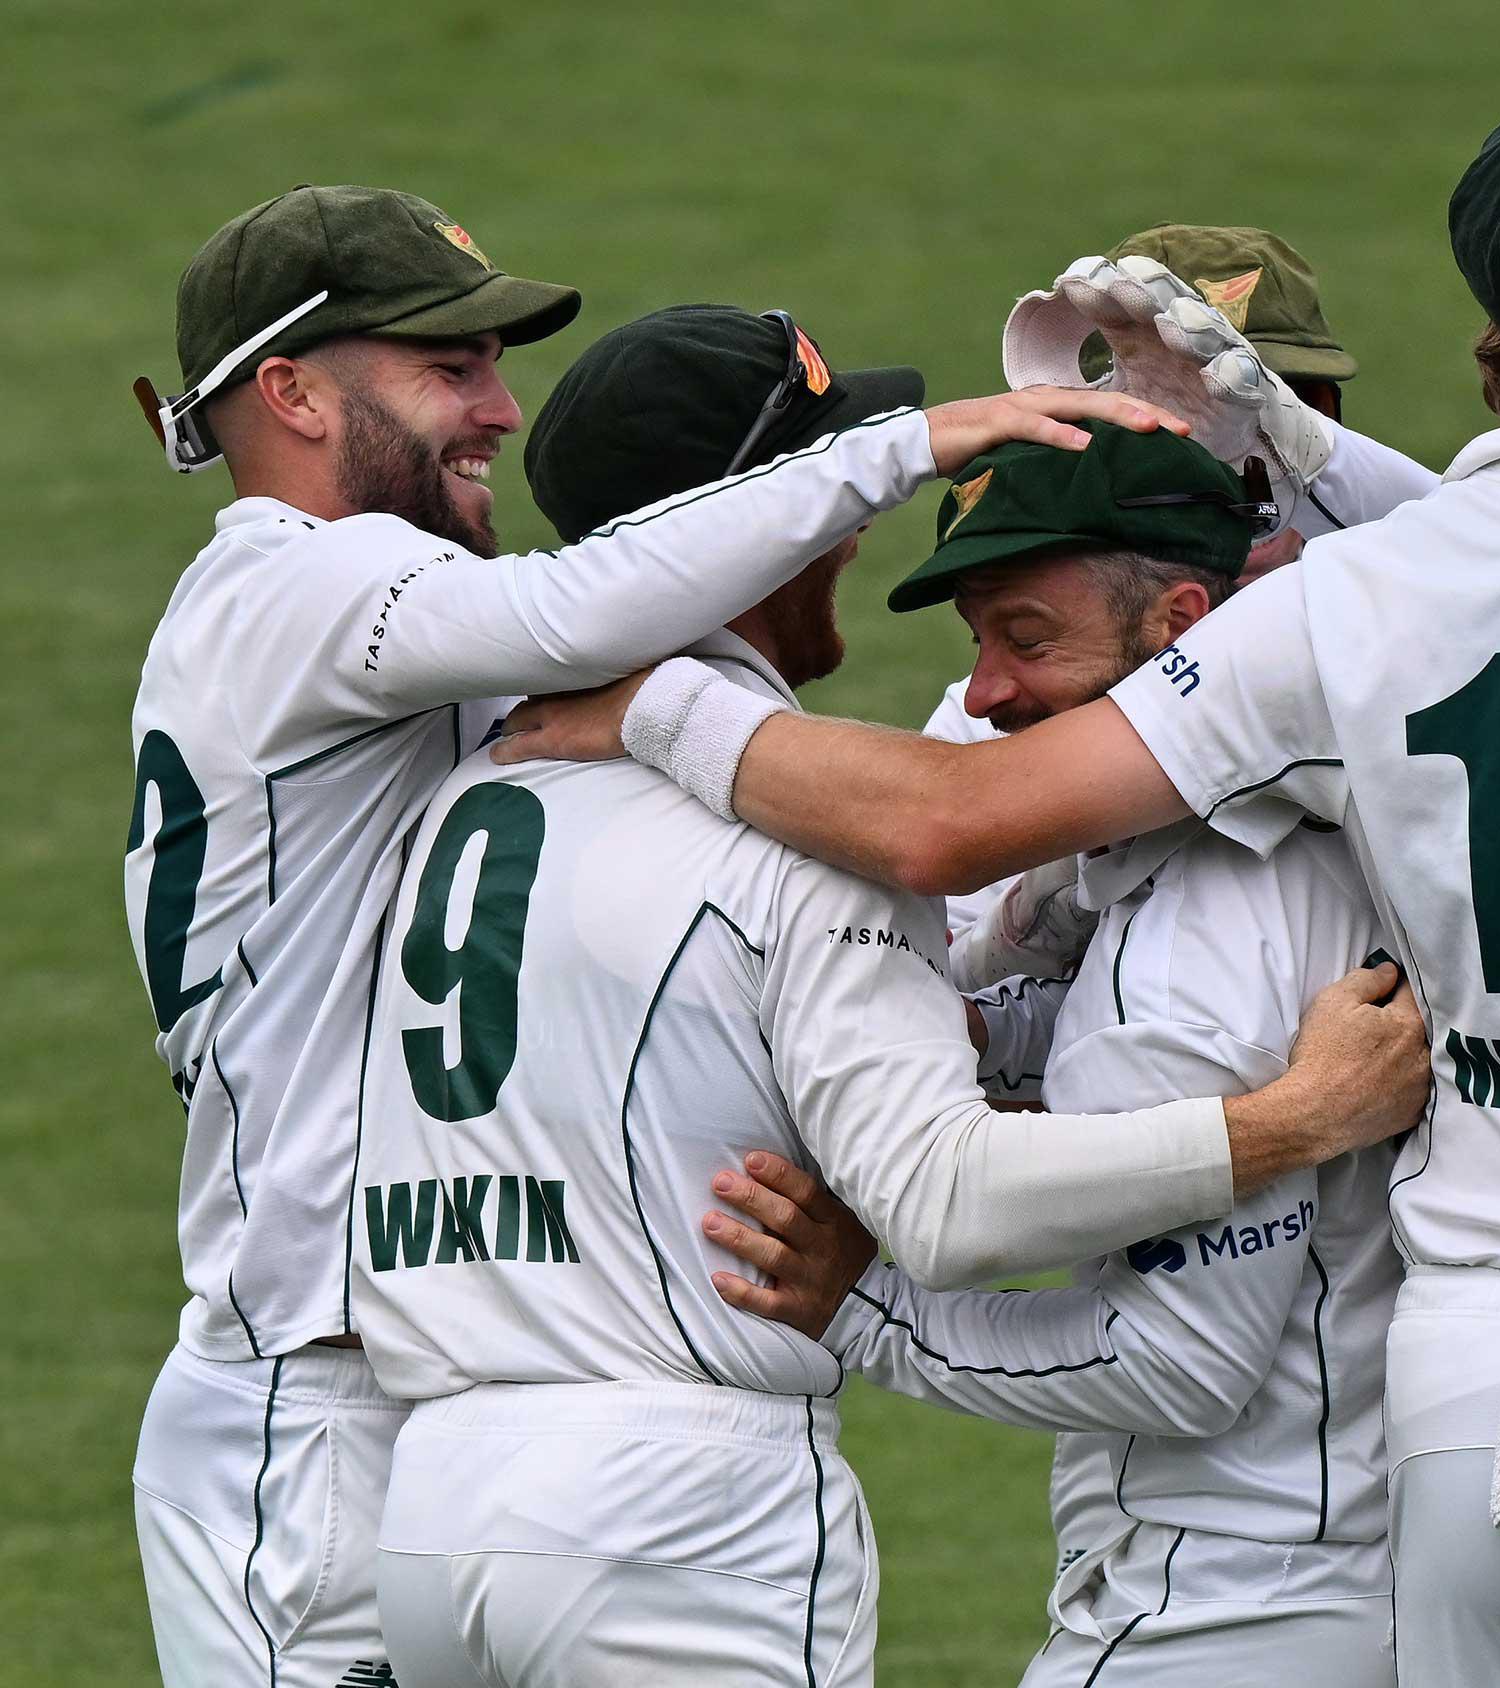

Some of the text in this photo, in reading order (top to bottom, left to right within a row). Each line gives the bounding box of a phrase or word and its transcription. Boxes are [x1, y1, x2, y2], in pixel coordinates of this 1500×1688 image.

[1154, 644, 1200, 698] rsh
[401, 781, 546, 1123] 9
[1197, 1200, 1314, 1267] Marsh
